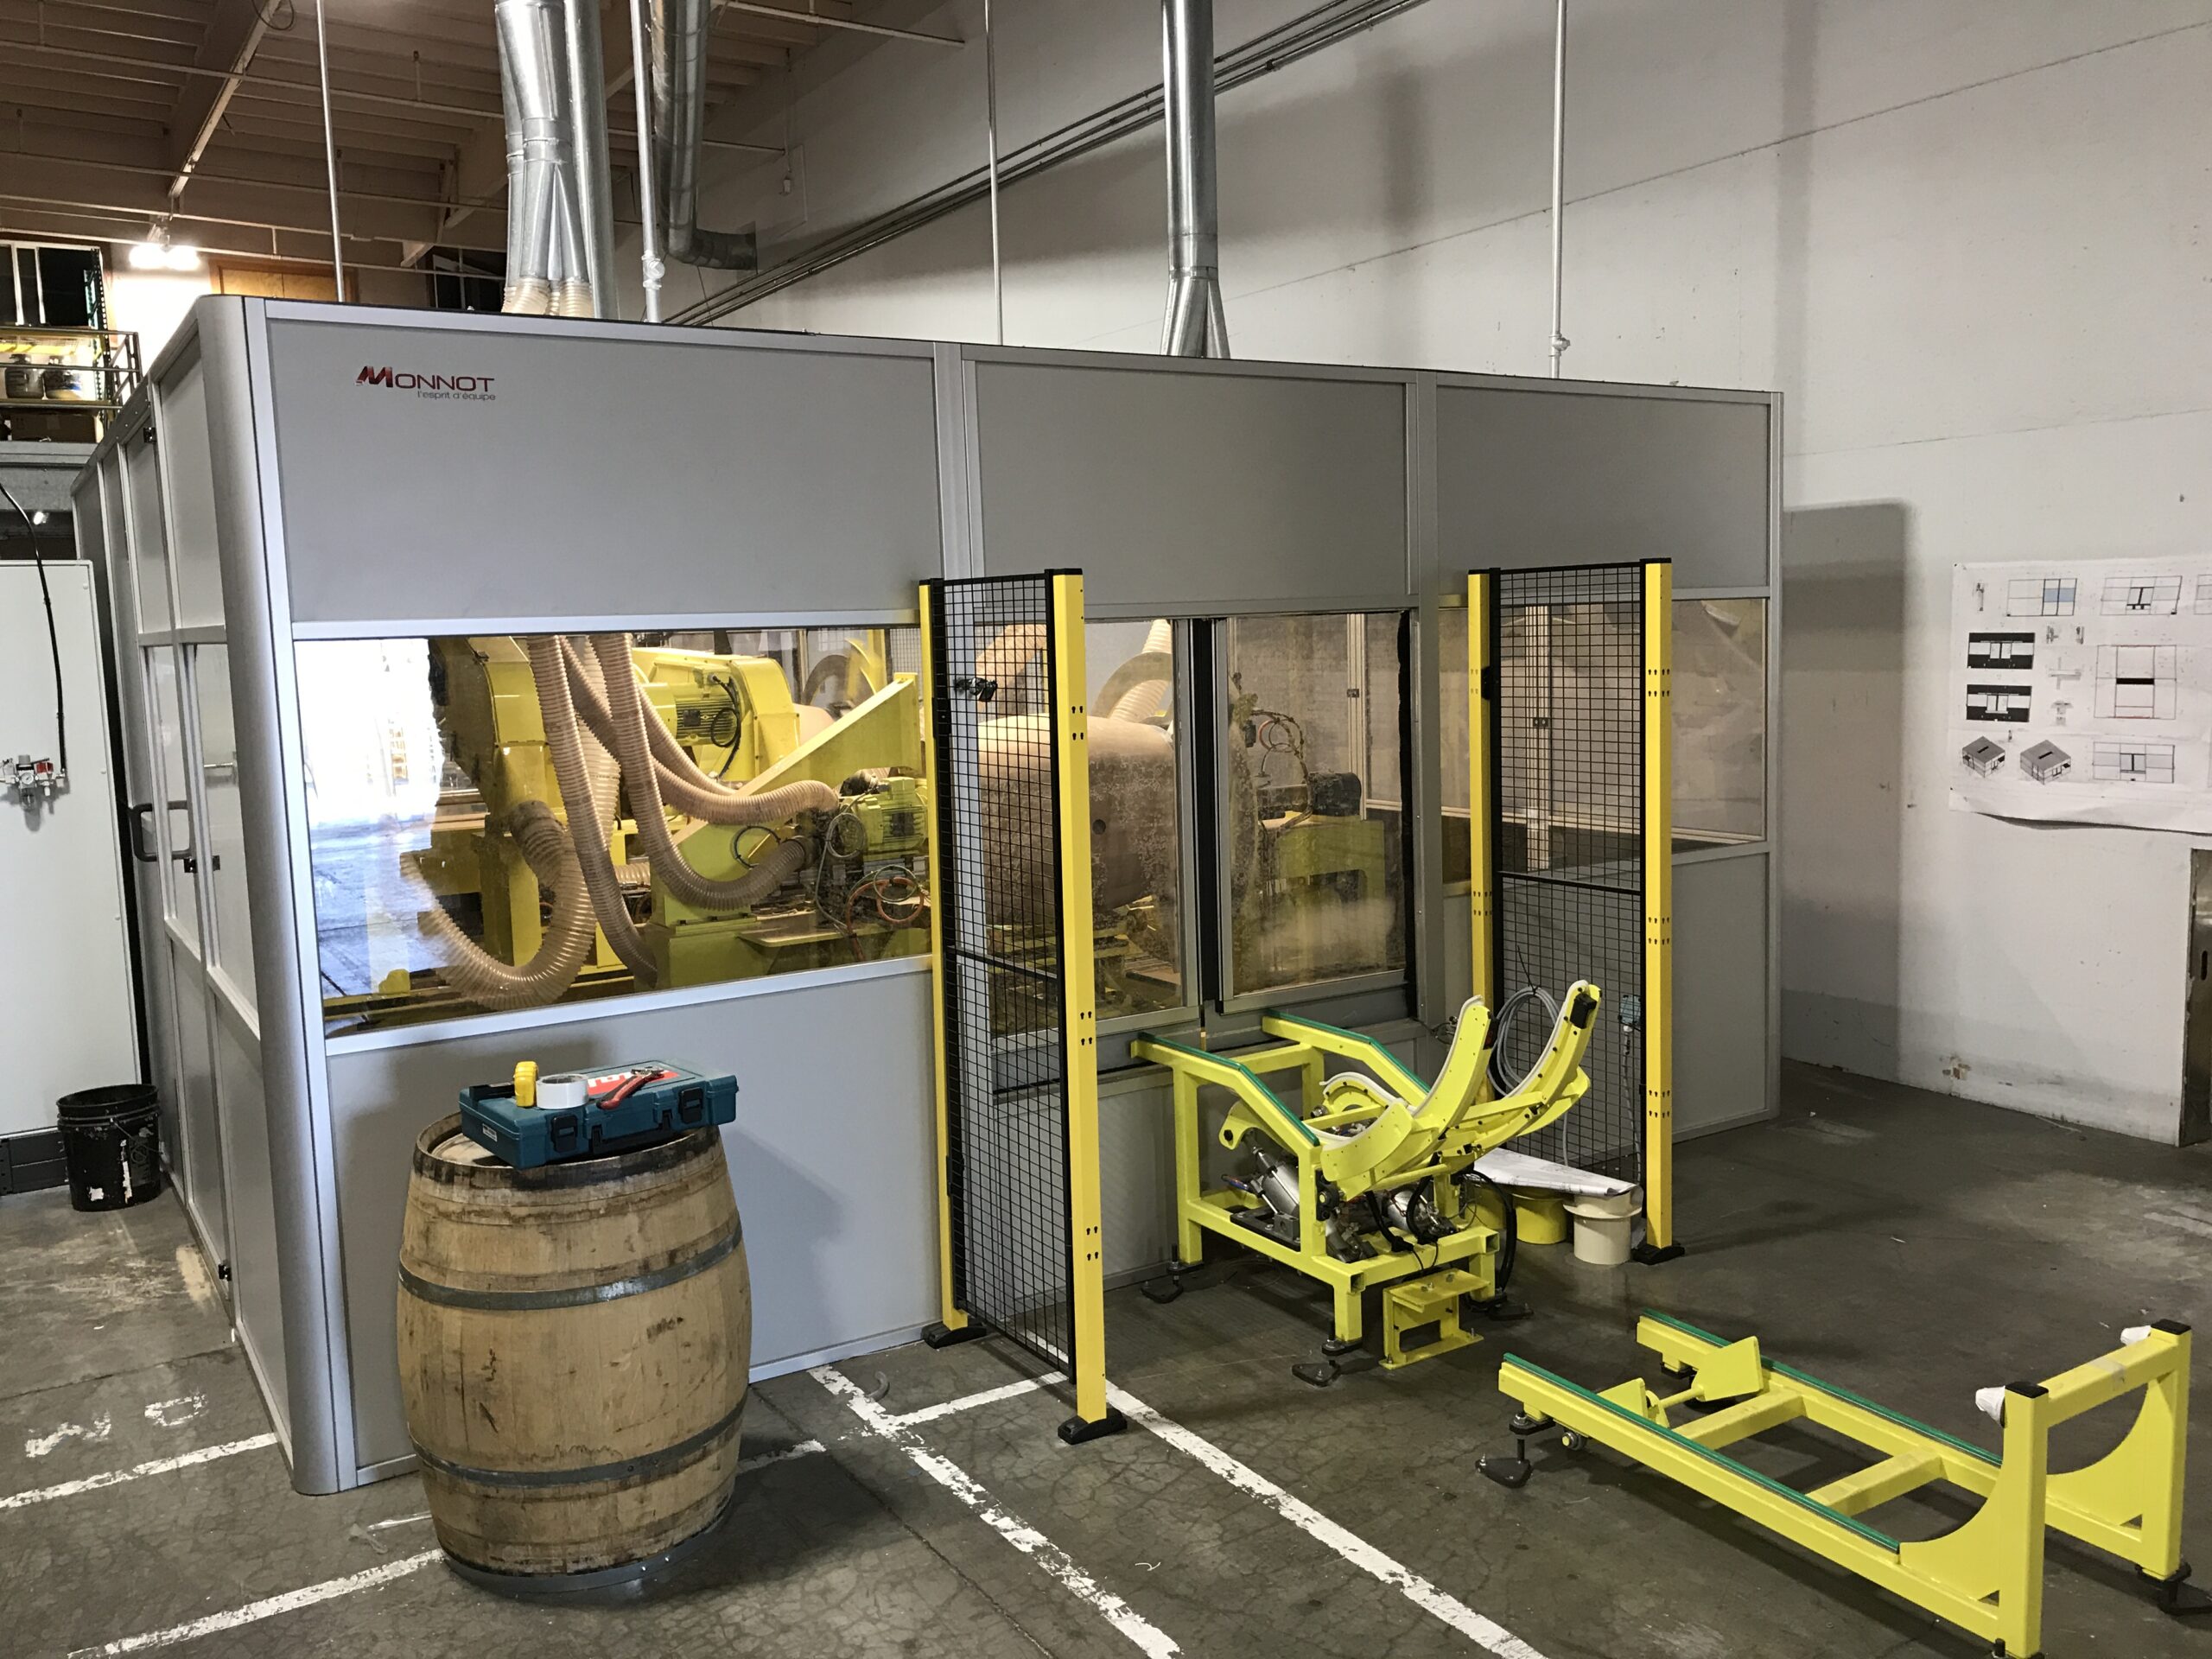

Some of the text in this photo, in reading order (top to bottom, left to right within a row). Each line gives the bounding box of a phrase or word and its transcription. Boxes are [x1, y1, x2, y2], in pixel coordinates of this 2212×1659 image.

[357, 365, 495, 392] MONNOT
[417, 391, 496, 401] l'esprit d'équipe
